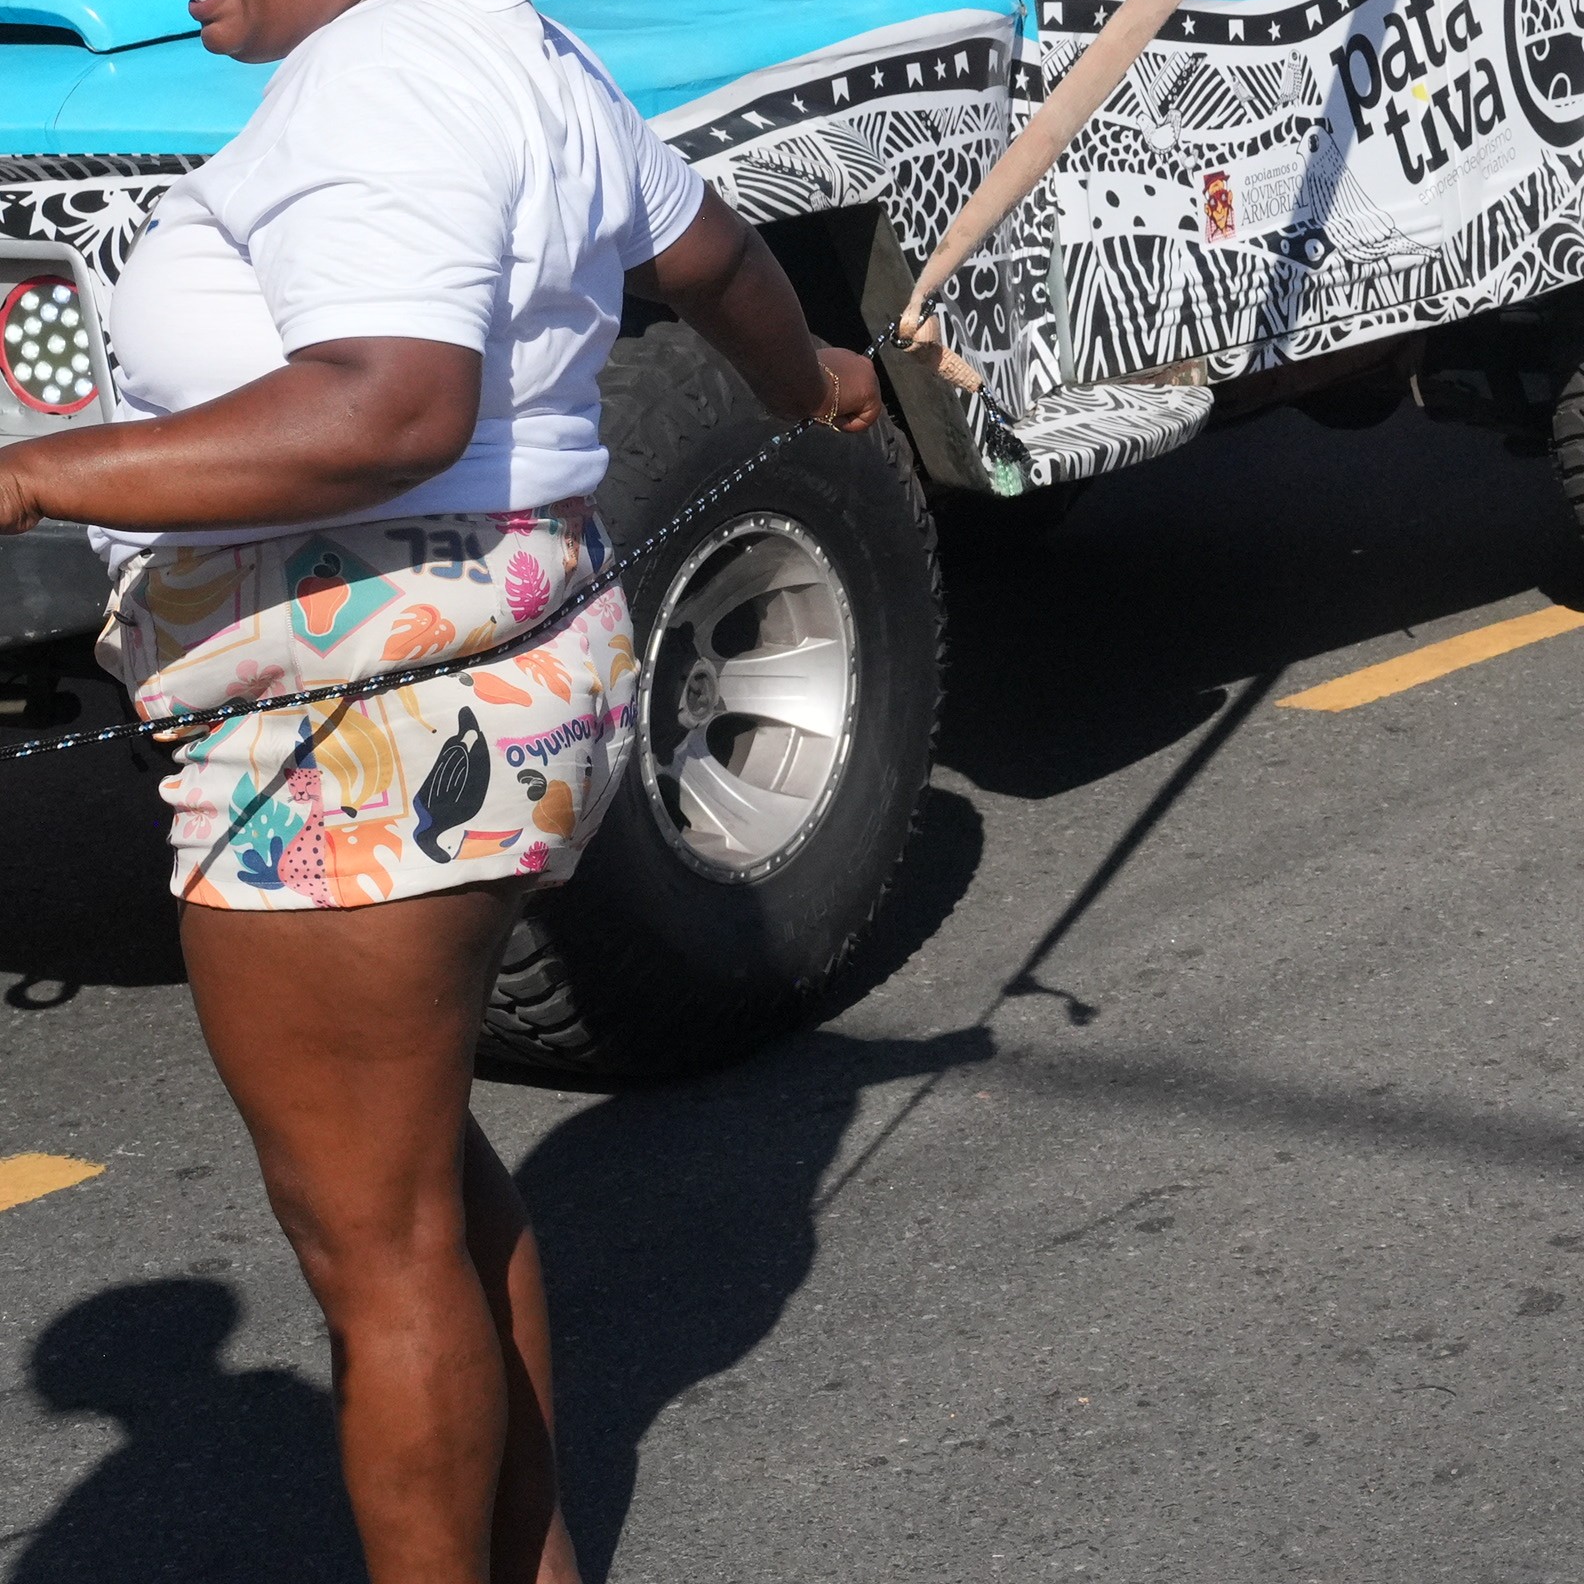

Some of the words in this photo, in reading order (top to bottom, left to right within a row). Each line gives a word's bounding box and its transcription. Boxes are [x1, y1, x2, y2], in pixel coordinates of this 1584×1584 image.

[1384, 58, 1506, 185] tiva
[1241, 174, 1303, 206] MOVIMENTO
[1244, 165, 1291, 187] apoiamos
[1241, 191, 1308, 226] ARMORIAL
[505, 718, 592, 768] novinho
